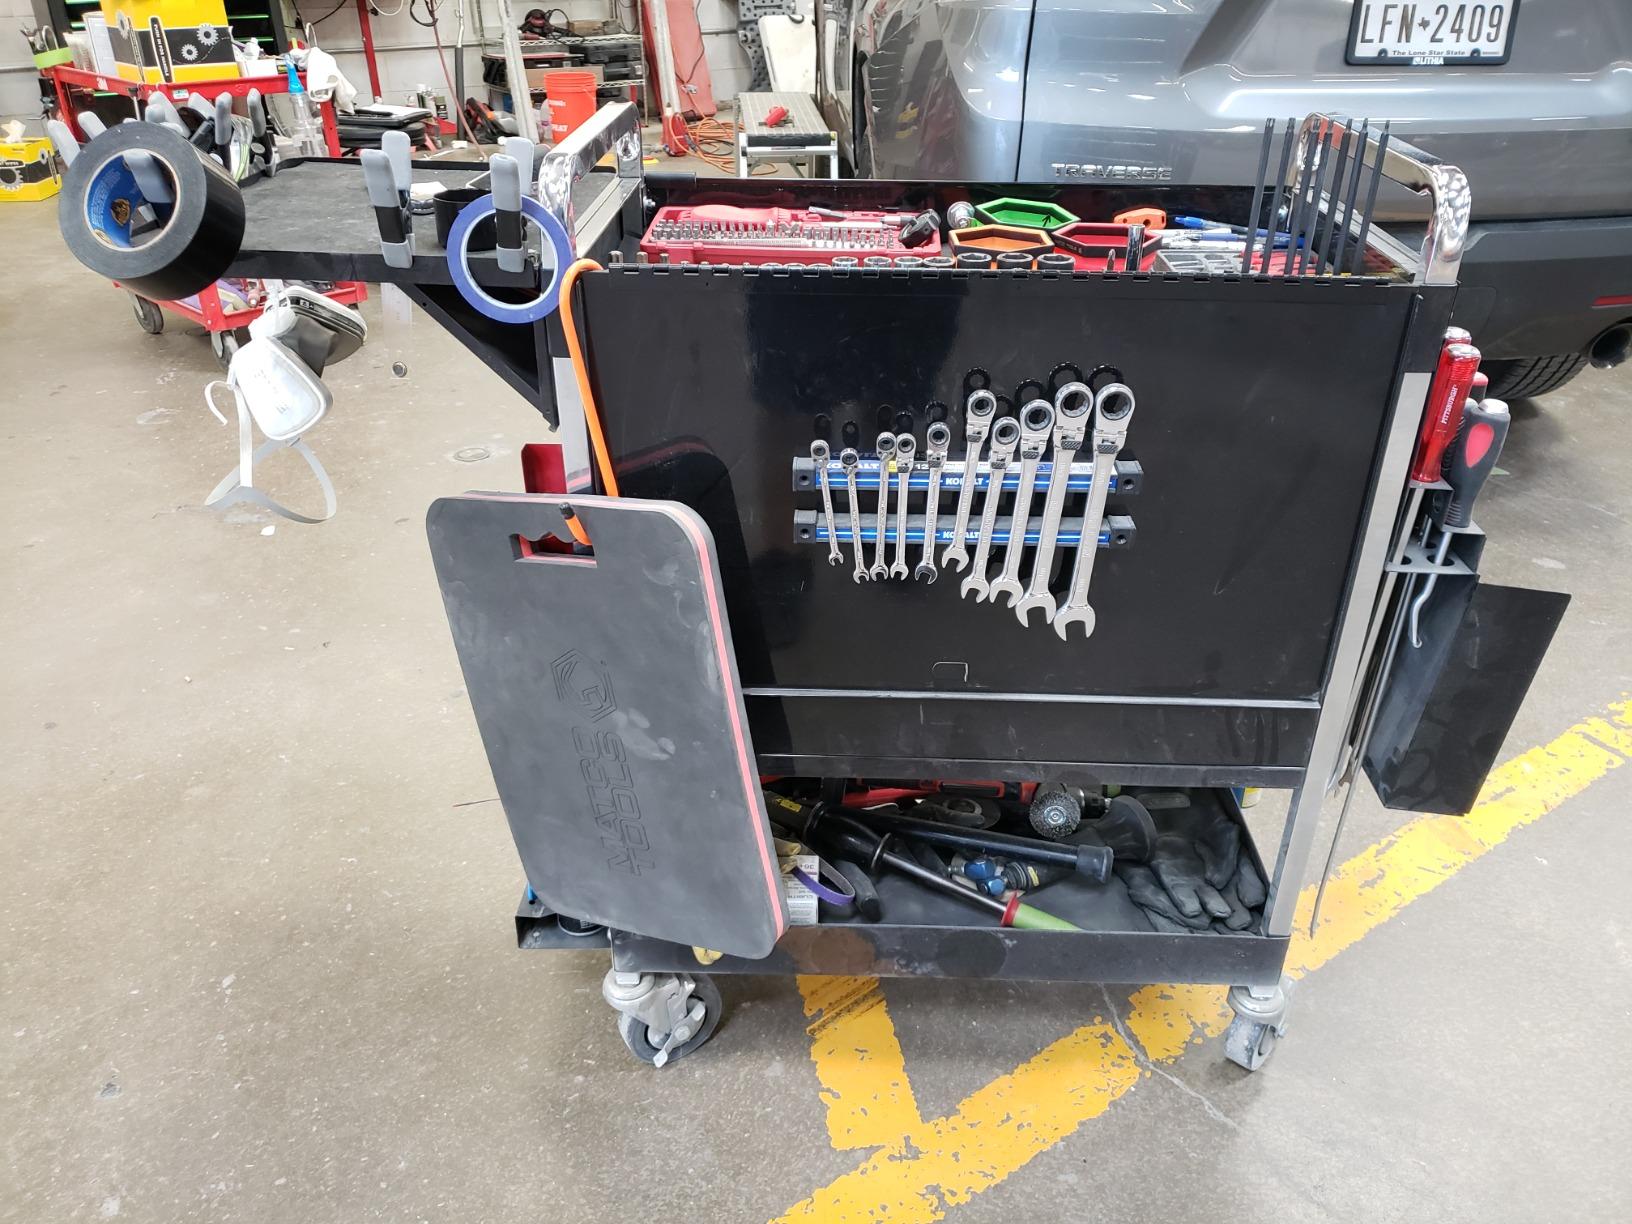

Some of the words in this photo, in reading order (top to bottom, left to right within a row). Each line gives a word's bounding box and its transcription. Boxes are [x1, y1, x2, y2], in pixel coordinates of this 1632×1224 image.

[1360, 4, 1417, 43] LFN
[1430, 4, 1504, 43] 2409
[1051, 163, 1172, 180] TRAVERSE
[571, 726, 632, 873] MATCO
[602, 730, 656, 877] TOOLS
